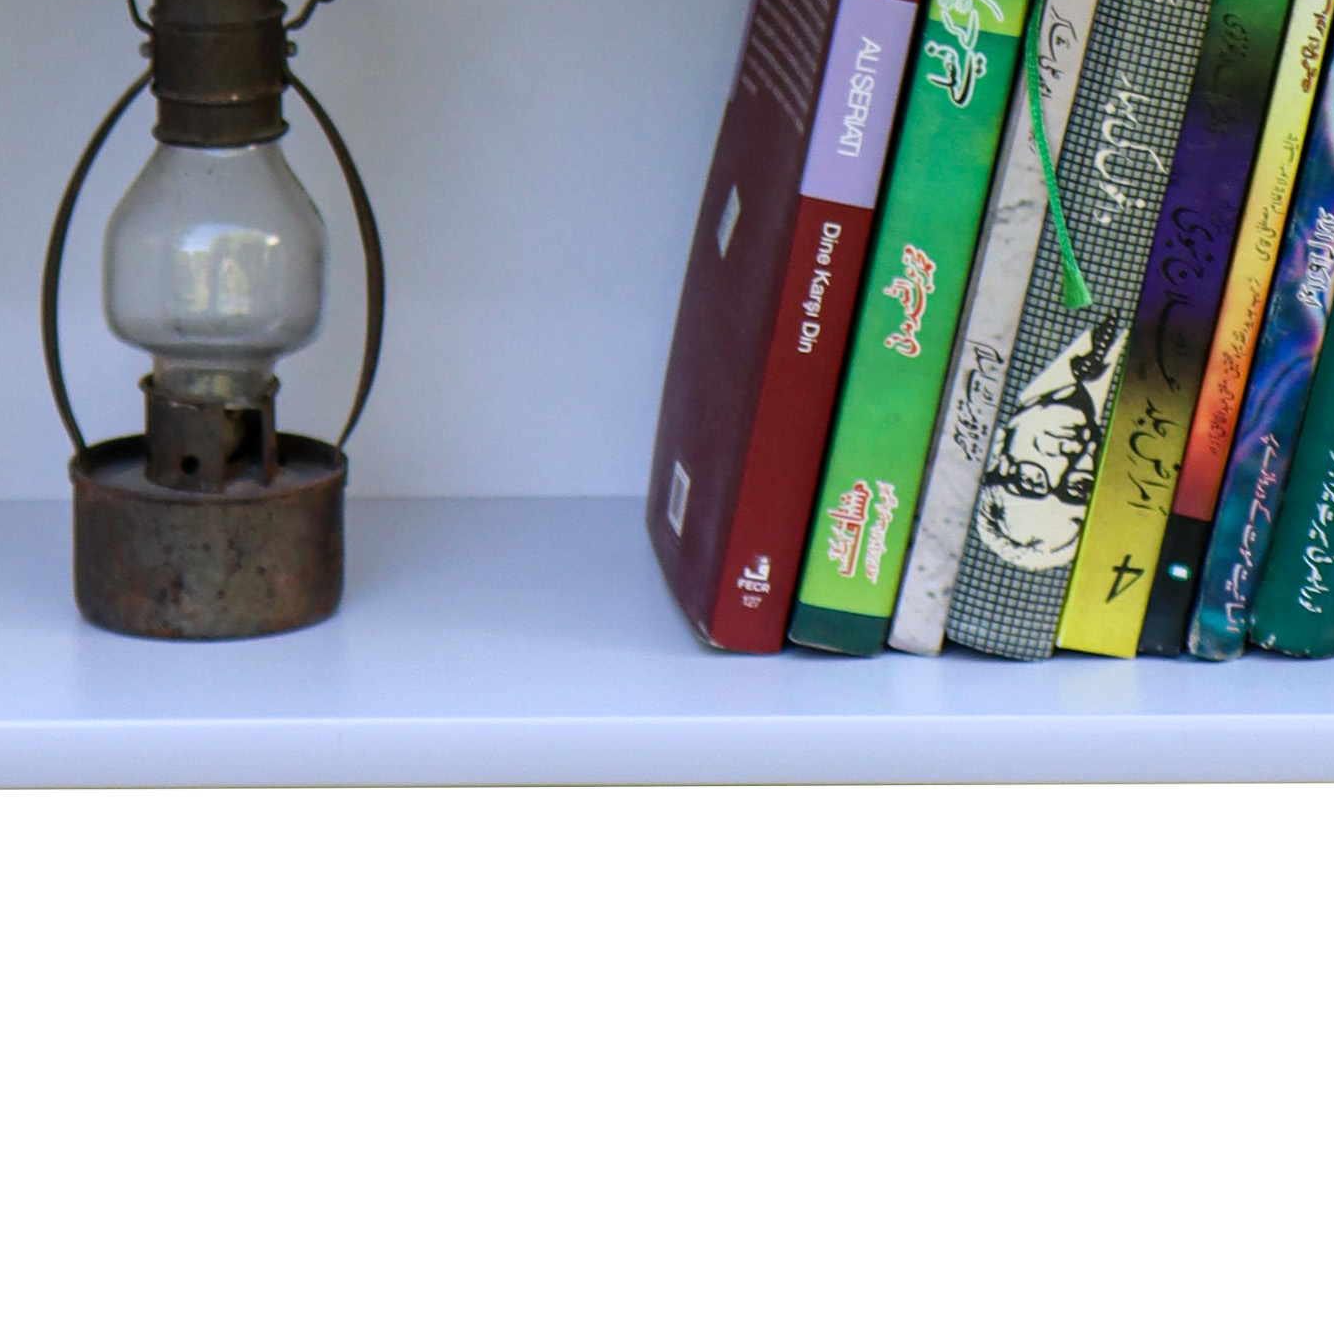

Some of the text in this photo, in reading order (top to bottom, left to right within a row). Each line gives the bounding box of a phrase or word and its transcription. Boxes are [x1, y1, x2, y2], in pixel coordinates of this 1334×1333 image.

[930, 4, 981, 50] کے
[1041, 5, 1078, 63] شاکر
[910, 41, 987, 106] فیصلے
[1035, 55, 1062, 80] علی
[797, 222, 842, 354] Dine Karşı Din
[956, 337, 1005, 381] اسلام
[955, 368, 996, 435] قومیت
[952, 425, 988, 462] متحدہ
[1212, 432, 1280, 633] انسانیت موت کے دروازے پر
[737, 577, 770, 593] FECR
[1105, 554, 1145, 604] 4
